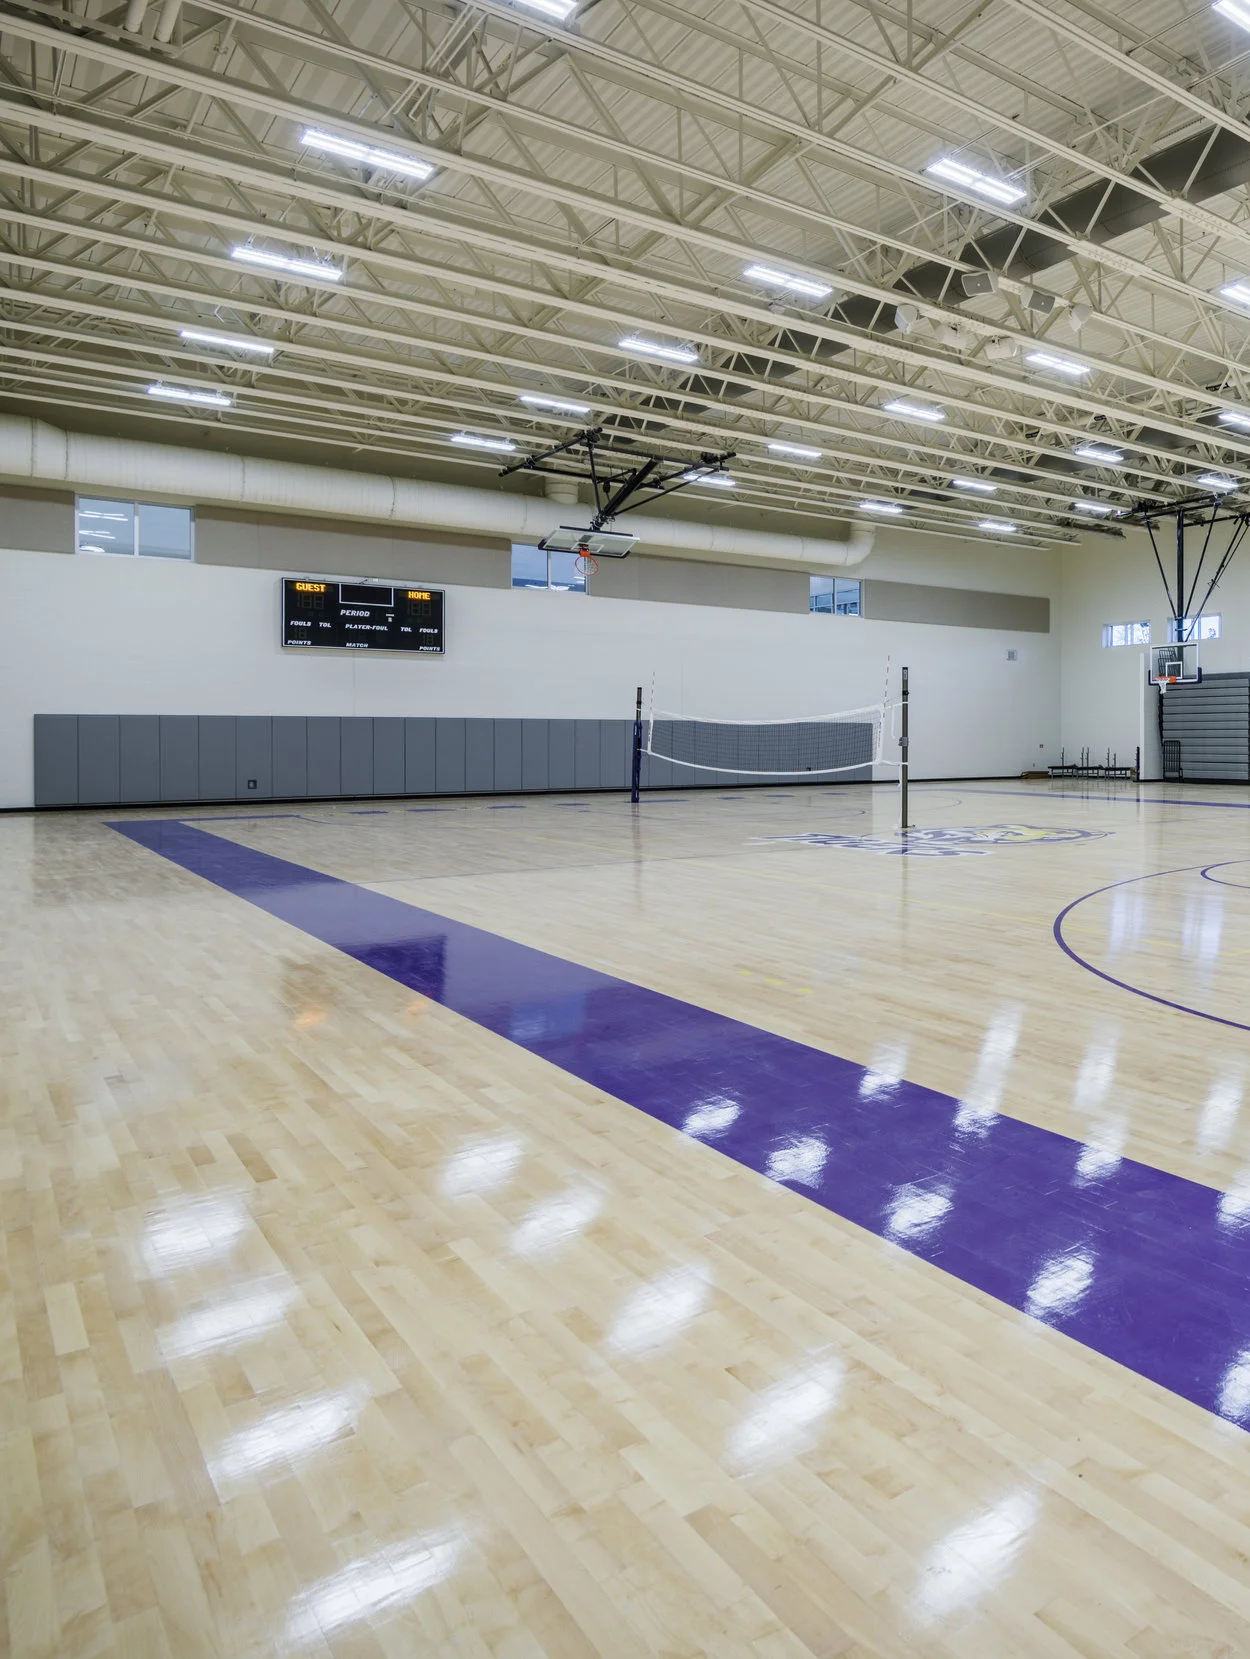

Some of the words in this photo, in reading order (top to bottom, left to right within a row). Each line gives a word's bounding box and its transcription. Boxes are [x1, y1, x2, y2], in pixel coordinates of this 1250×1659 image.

[296, 583, 326, 592] GUEST
[408, 591, 431, 600] HOME
[340, 609, 370, 617] PERIOD
